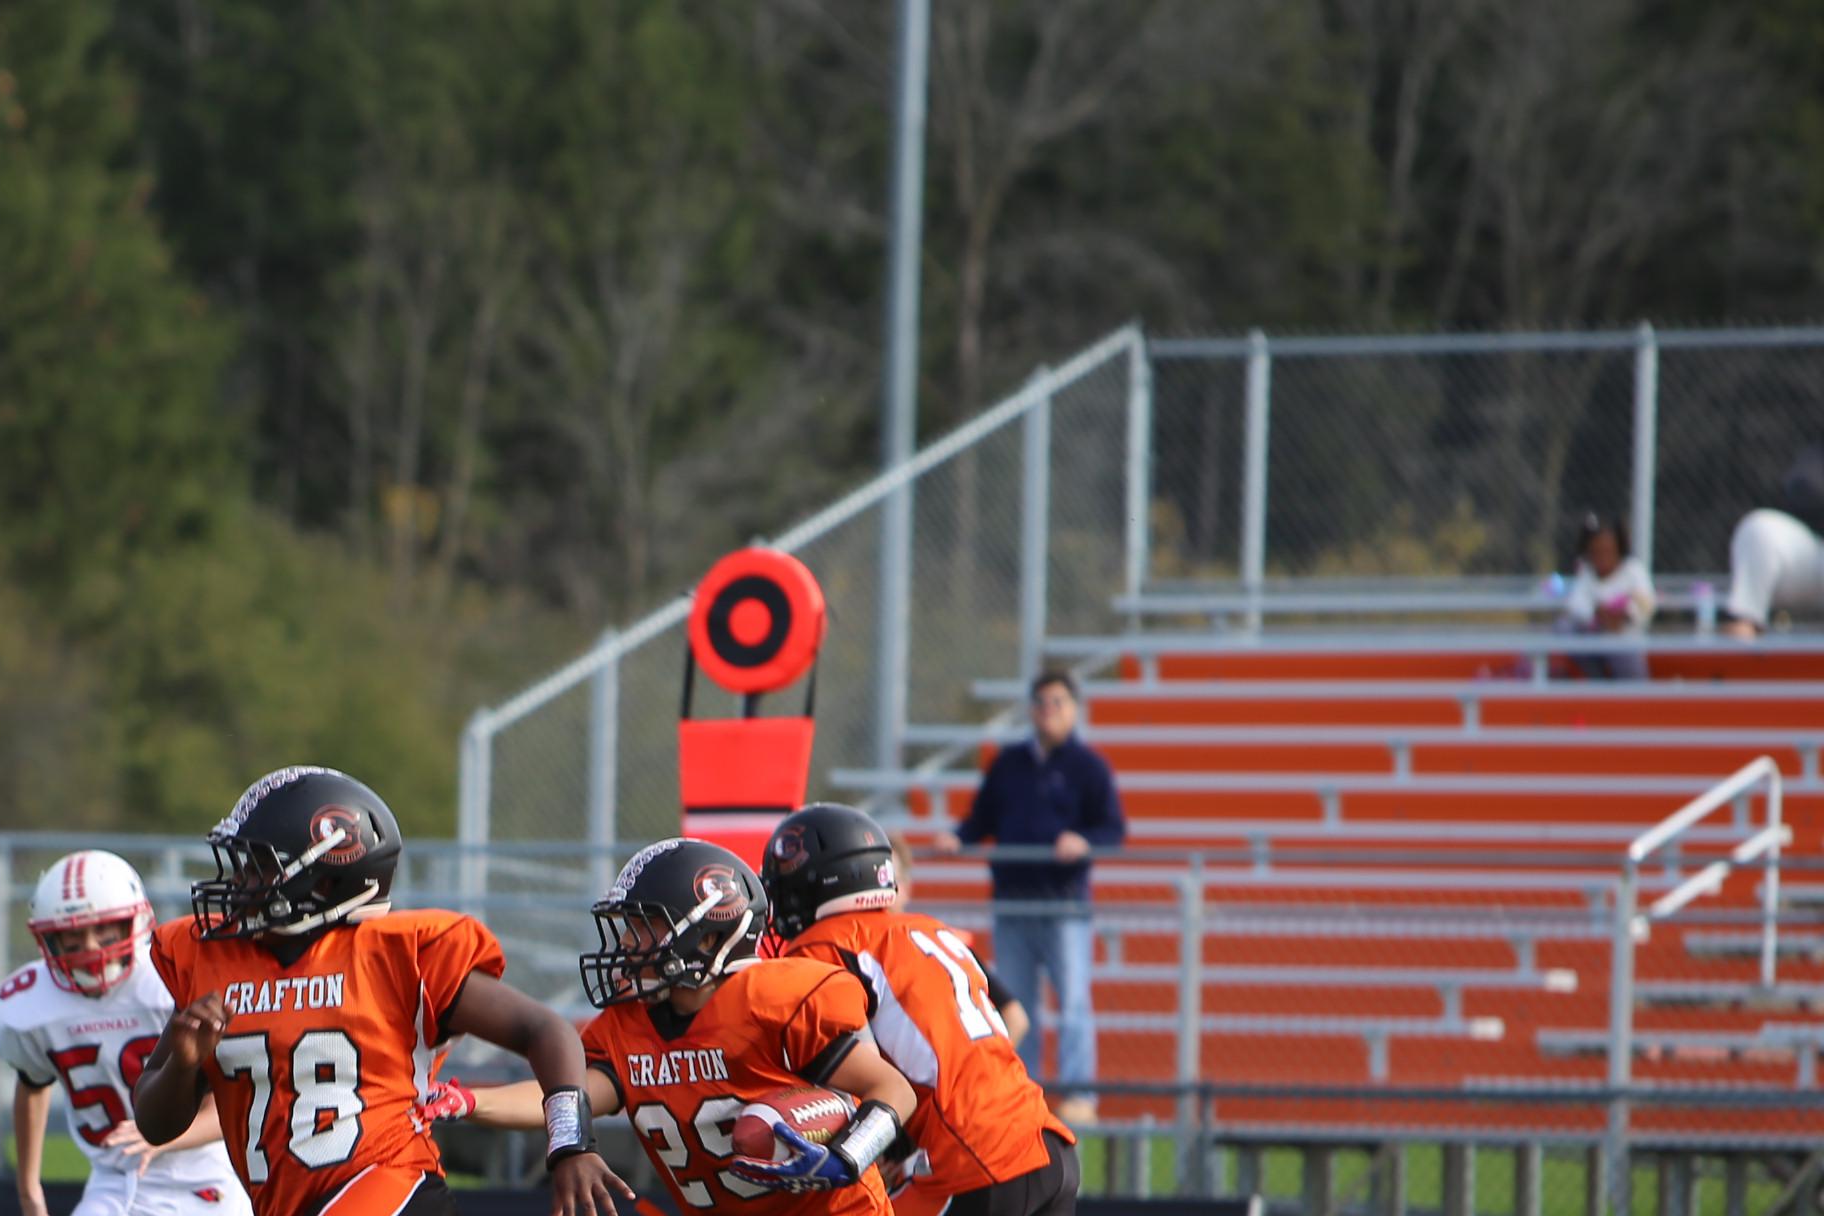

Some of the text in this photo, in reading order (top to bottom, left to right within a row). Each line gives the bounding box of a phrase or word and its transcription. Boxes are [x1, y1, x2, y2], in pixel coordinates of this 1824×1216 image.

[224, 973, 344, 1015] GRAFTON
[627, 1048, 729, 1087] GRAFTON
[214, 1029, 365, 1184] 78
